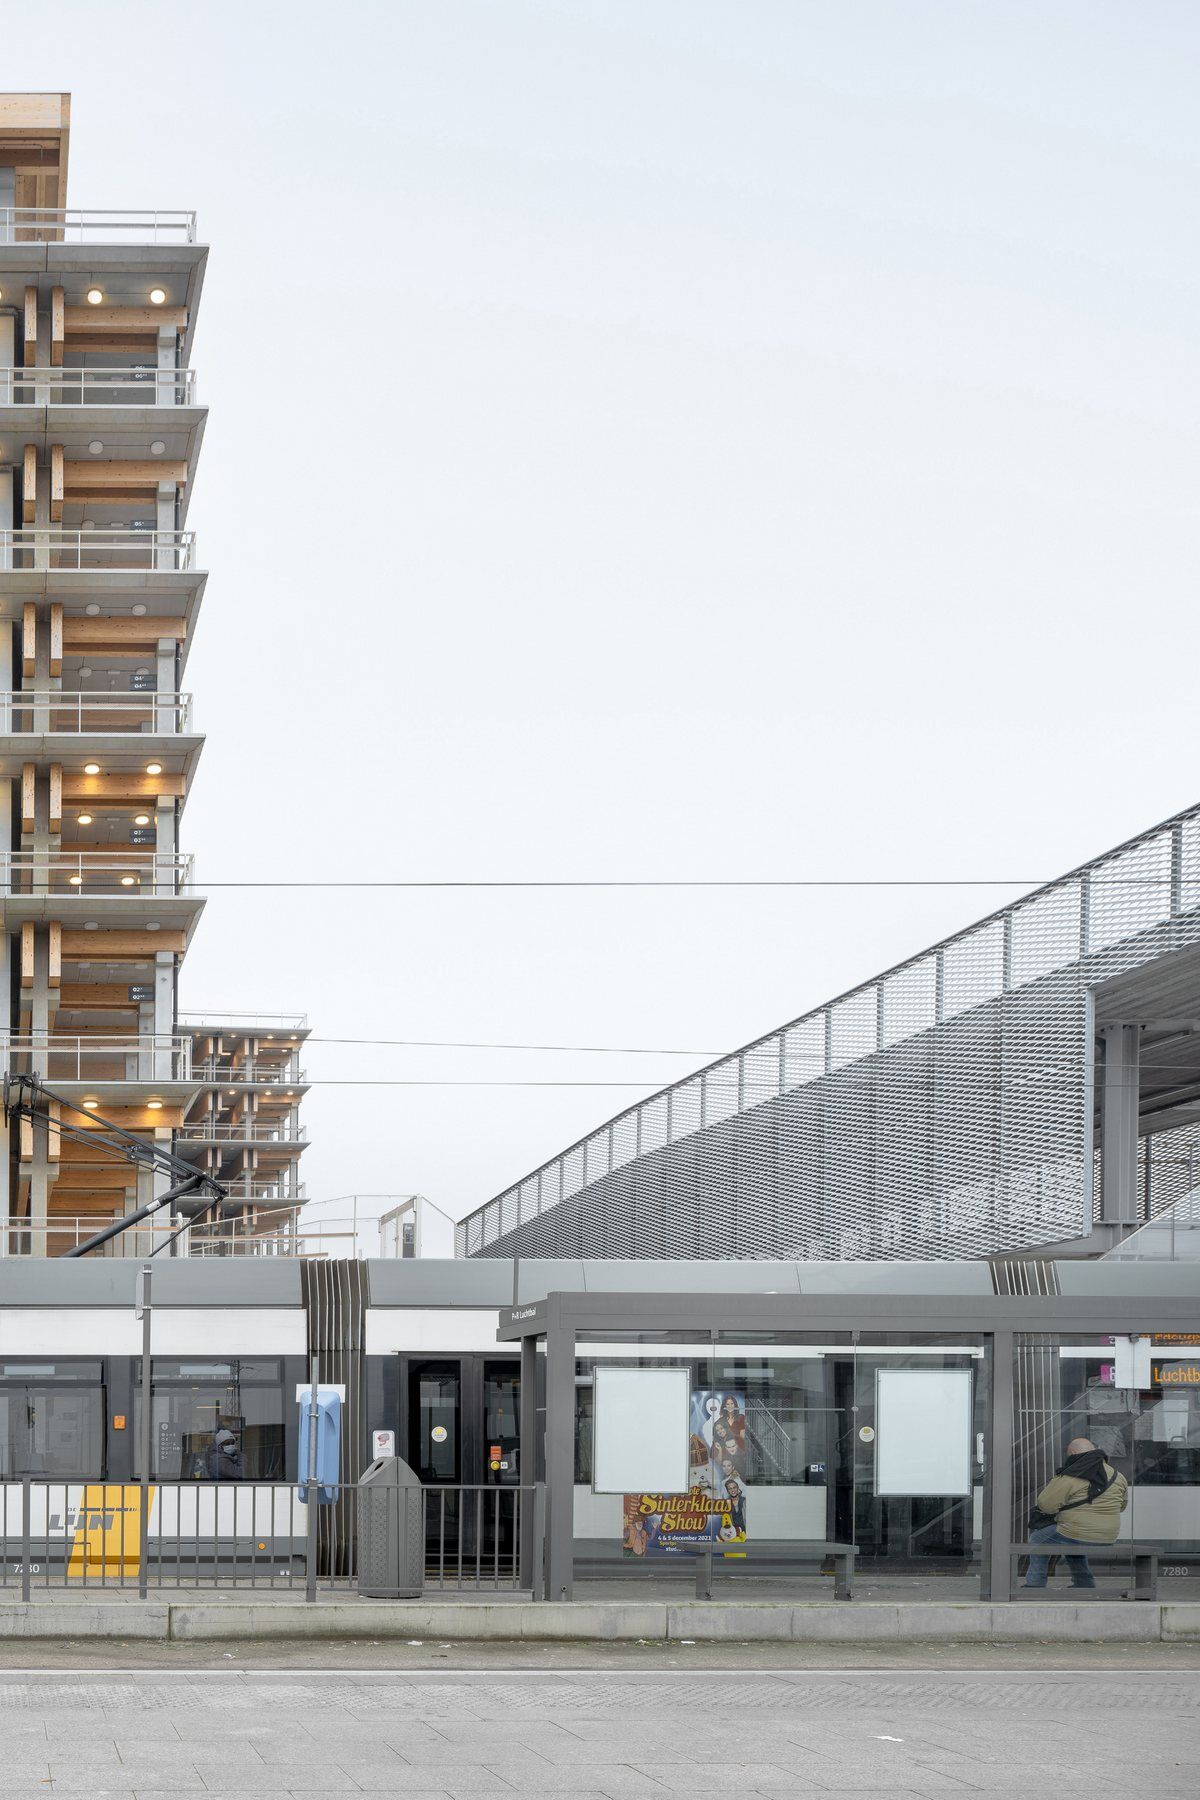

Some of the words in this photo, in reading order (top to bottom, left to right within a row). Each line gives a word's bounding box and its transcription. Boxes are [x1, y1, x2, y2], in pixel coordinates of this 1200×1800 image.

[520, 1307, 537, 1319] Luchtbal
[640, 1495, 732, 1514] Sinterklaas
[661, 1513, 706, 1531] Show
[1162, 1566, 1189, 1576] 7280
